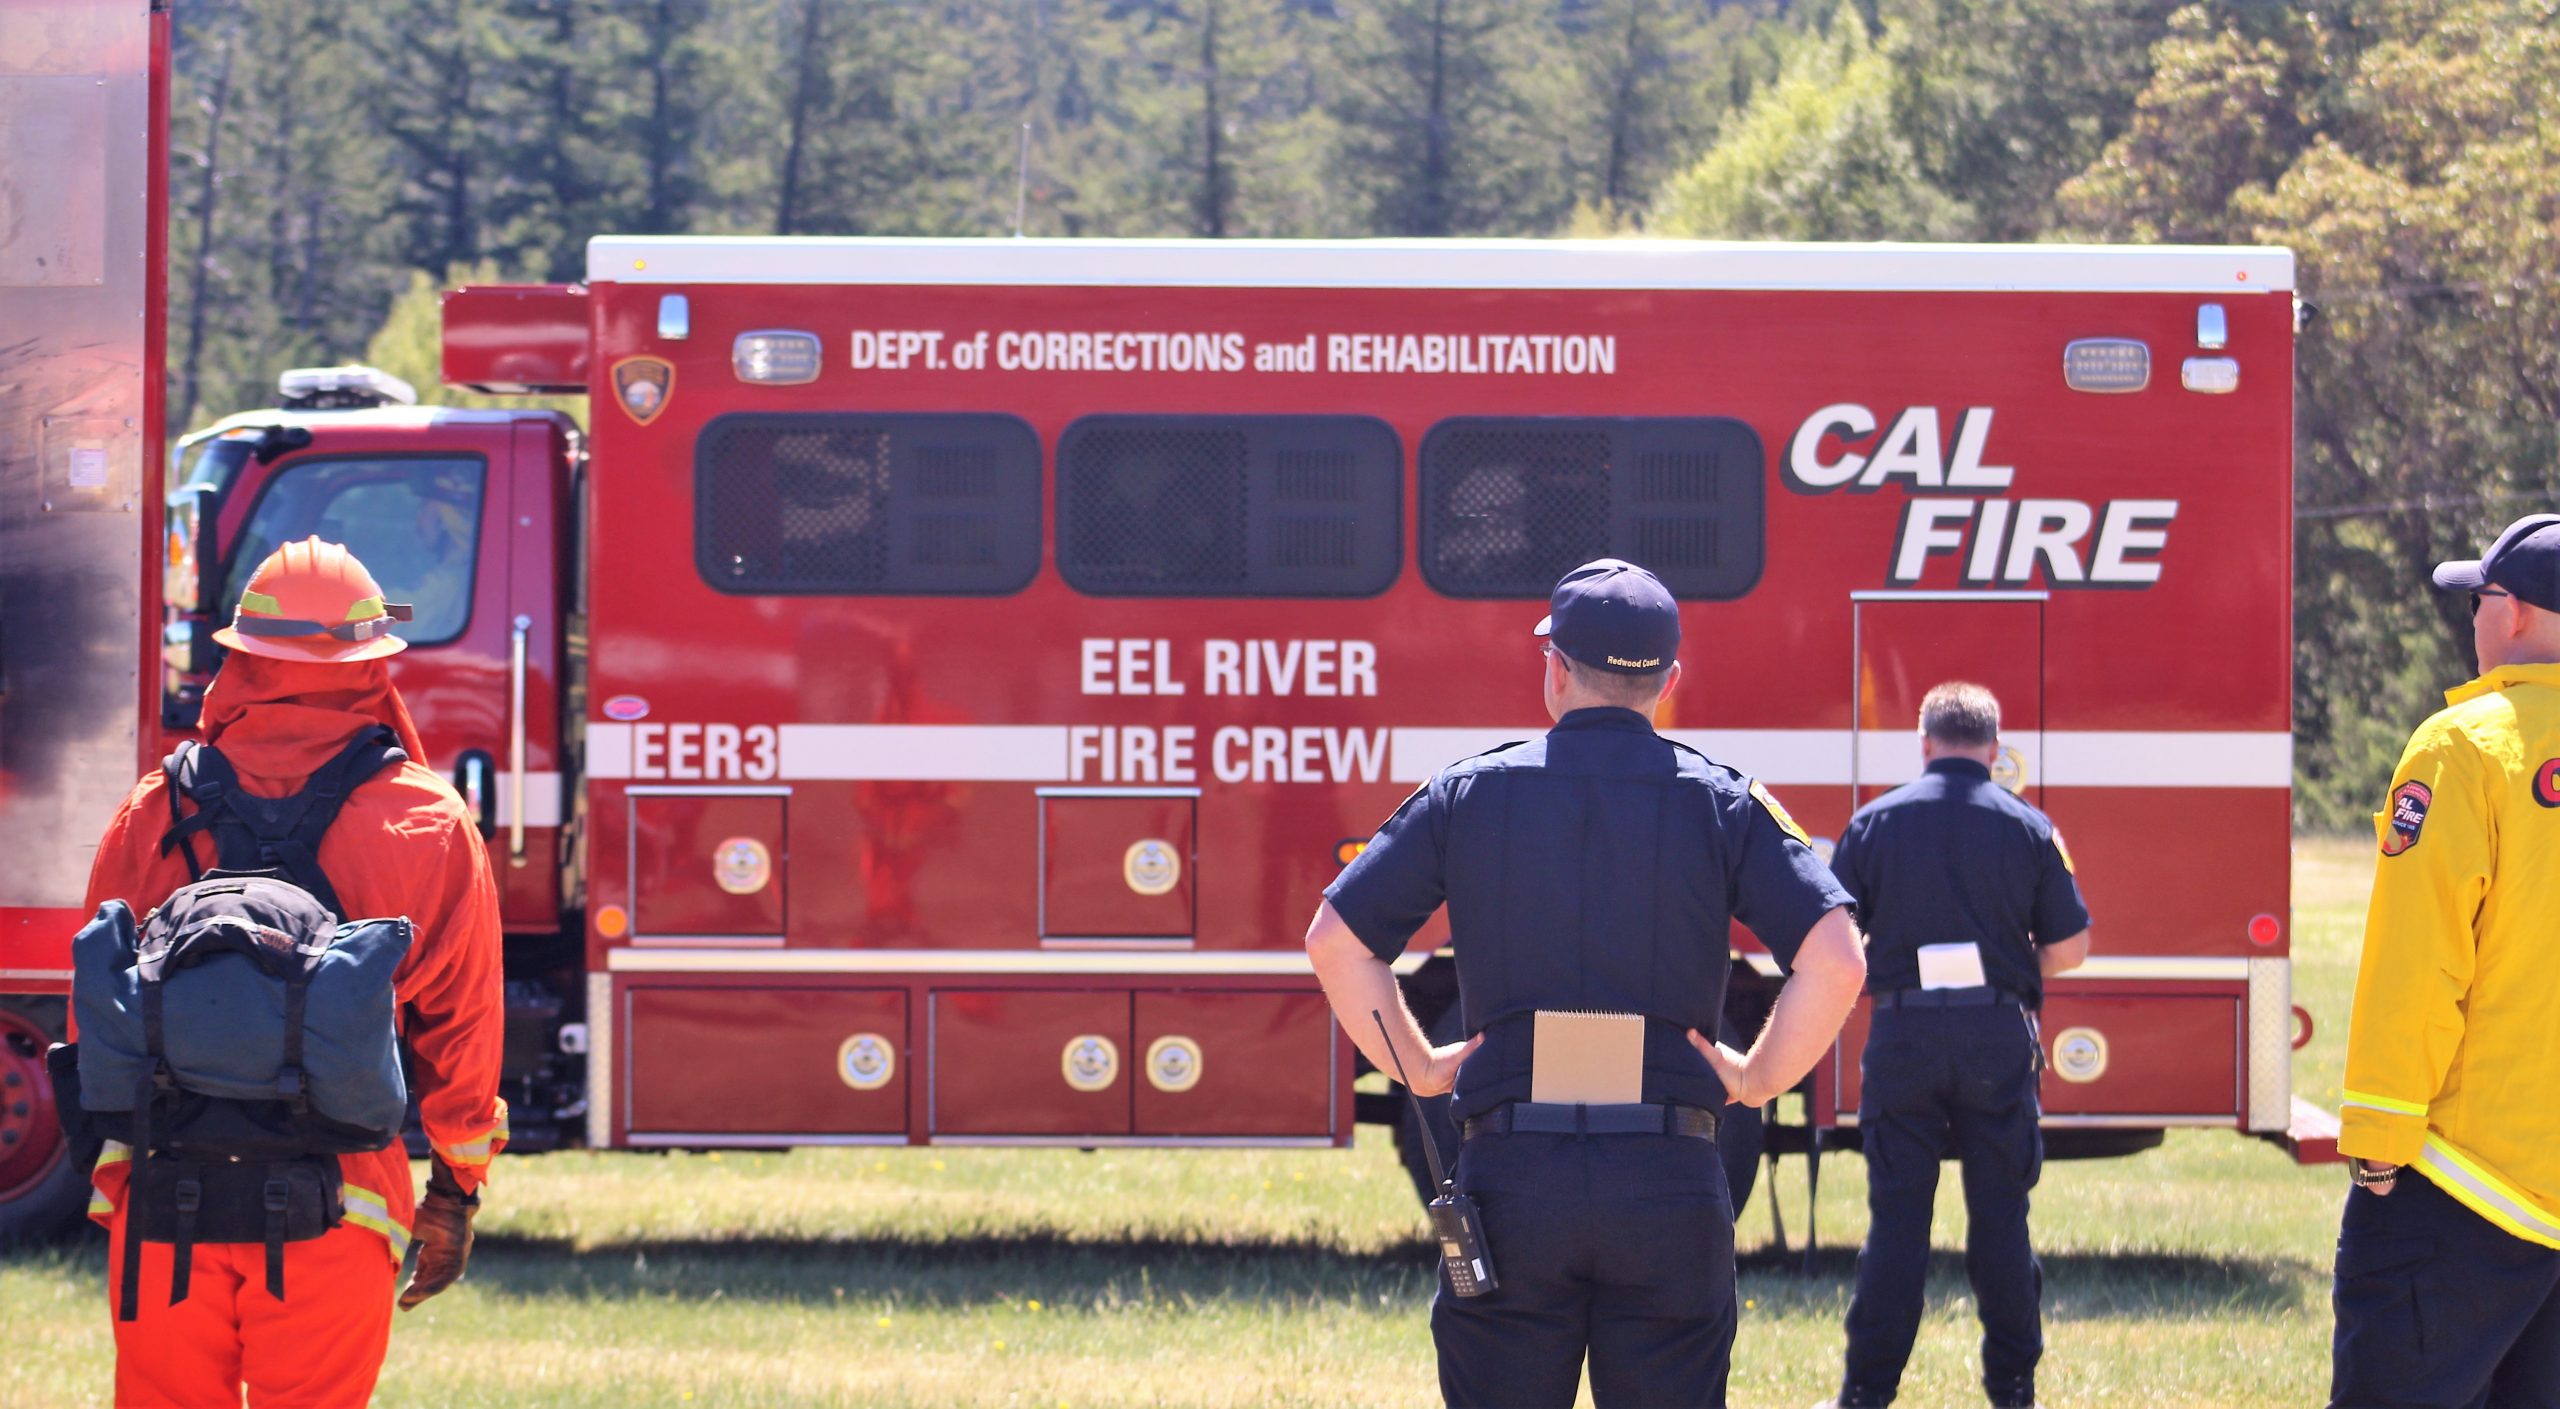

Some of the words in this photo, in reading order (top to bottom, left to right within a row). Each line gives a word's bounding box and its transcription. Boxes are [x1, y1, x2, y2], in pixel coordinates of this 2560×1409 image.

[852, 330, 947, 370] DEPT.
[952, 331, 989, 370] of
[996, 332, 1245, 371] CORRECTIONS
[1253, 334, 1316, 373] and
[1327, 334, 1616, 374] REHABILITATION
[1784, 403, 2015, 491] CAL
[1890, 498, 2179, 584] FIRE
[1081, 638, 1186, 695] EEL
[1204, 639, 1378, 697] RIVER
[1607, 655, 1641, 667] Redwood
[1642, 657, 1659, 667] Coast
[634, 723, 776, 781] EER3
[1070, 726, 1196, 782] FIRE
[1212, 726, 1389, 783] CREW
[2394, 807, 2424, 824] FIRE
[2398, 797, 2413, 810] AL
